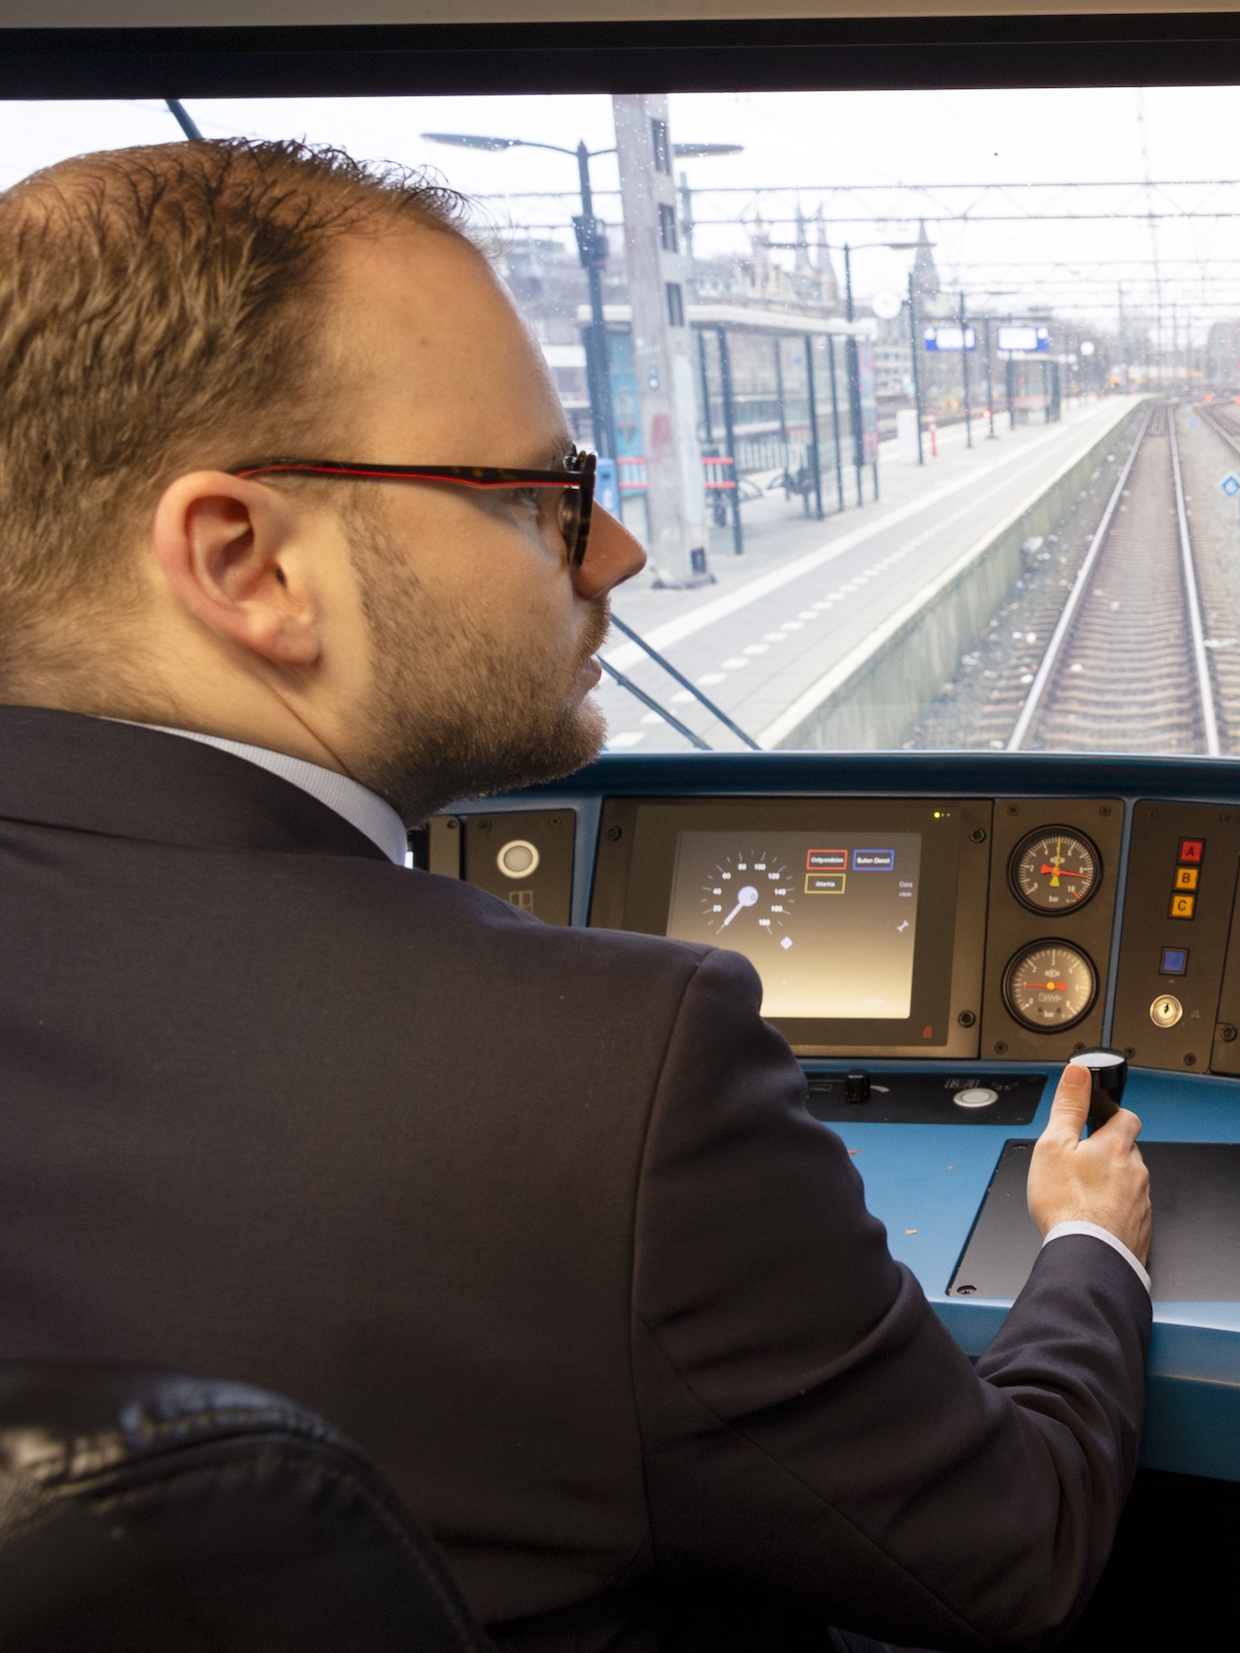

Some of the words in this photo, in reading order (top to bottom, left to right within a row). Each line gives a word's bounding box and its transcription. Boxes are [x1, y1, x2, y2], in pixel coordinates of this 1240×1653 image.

[1186, 846, 1194, 856] A
[754, 863, 766, 871] 100
[768, 872, 780, 880] 120
[1182, 872, 1190, 883] B
[774, 888, 786, 896] 140
[1178, 900, 1187, 911] C
